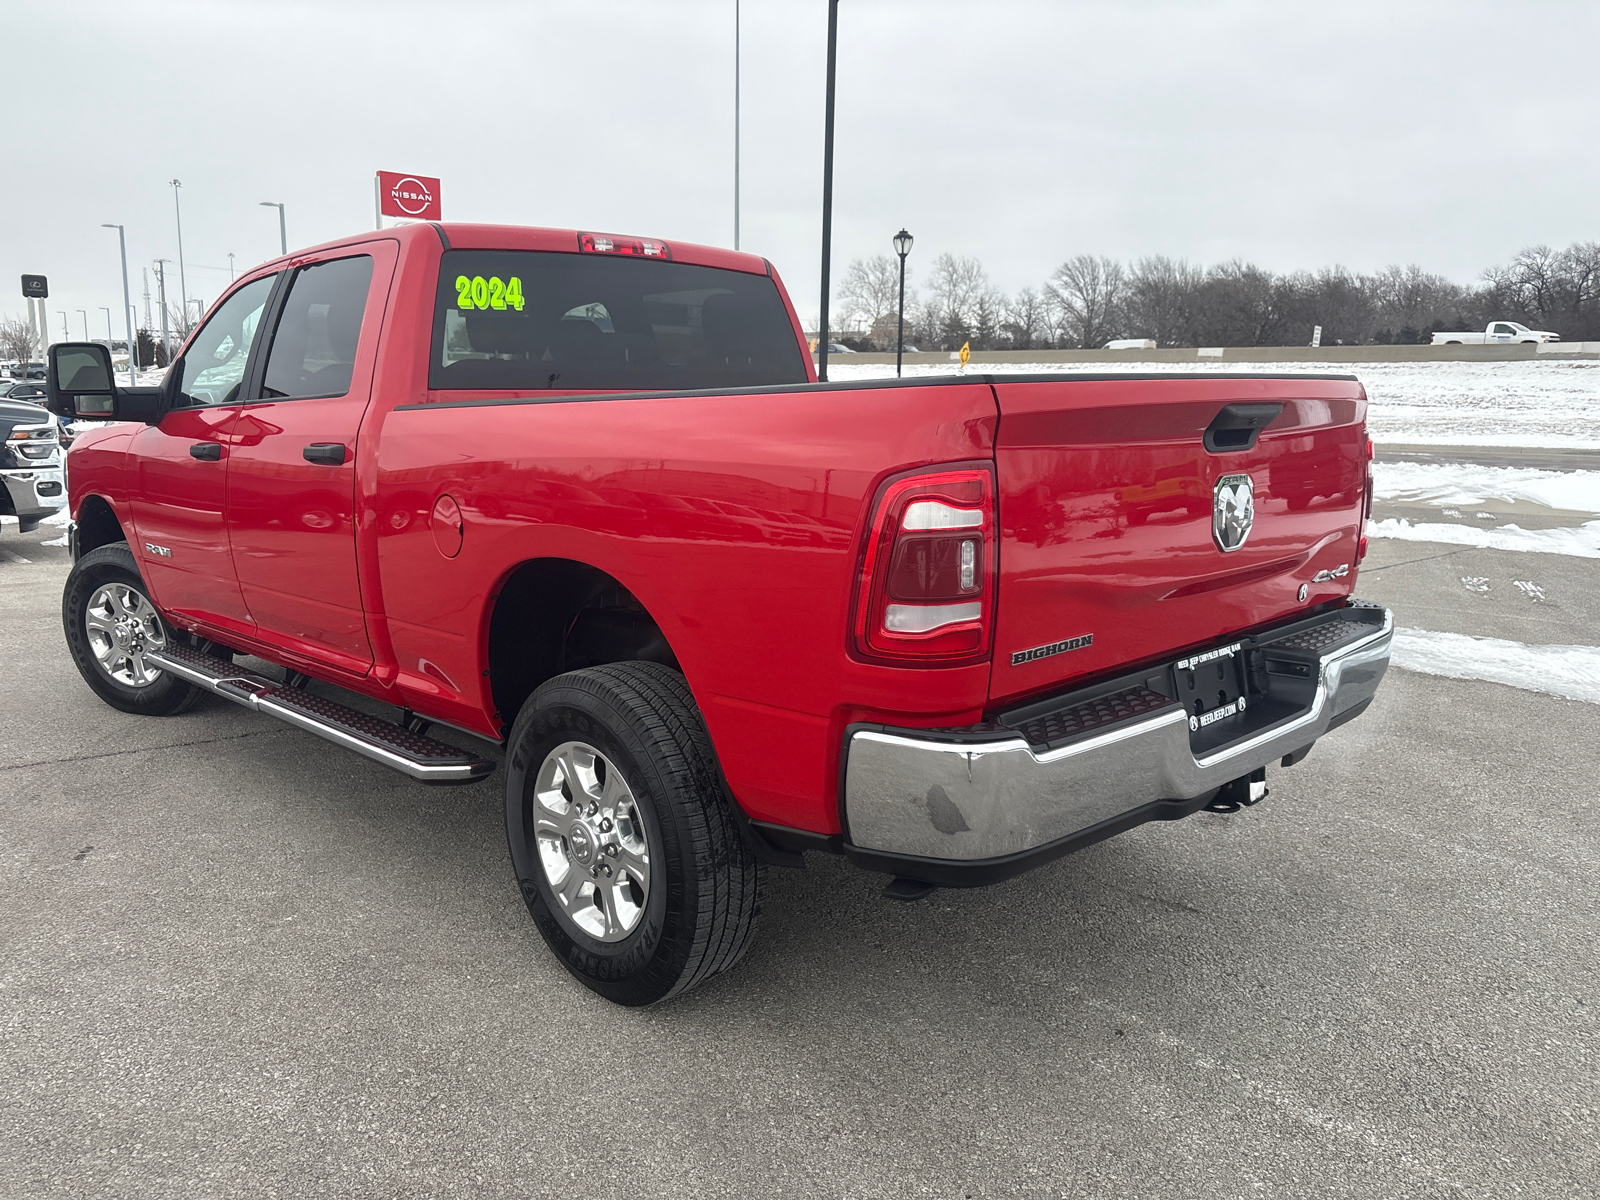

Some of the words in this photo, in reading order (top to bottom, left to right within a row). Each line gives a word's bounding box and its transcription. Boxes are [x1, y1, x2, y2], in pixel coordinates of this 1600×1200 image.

[391, 190, 432, 202] NISSAN
[455, 275, 525, 311] 2024
[145, 542, 172, 558] RAM
[1010, 633, 1094, 667] BIGHORN
[1177, 659, 1189, 670] REED
[1190, 656, 1199, 666] JEEP
[1199, 650, 1219, 663] CHRYSLER
[1218, 645, 1232, 657] DODGE
[1230, 642, 1242, 653] RAM
[1200, 703, 1236, 727] REEDJEEP.COM
